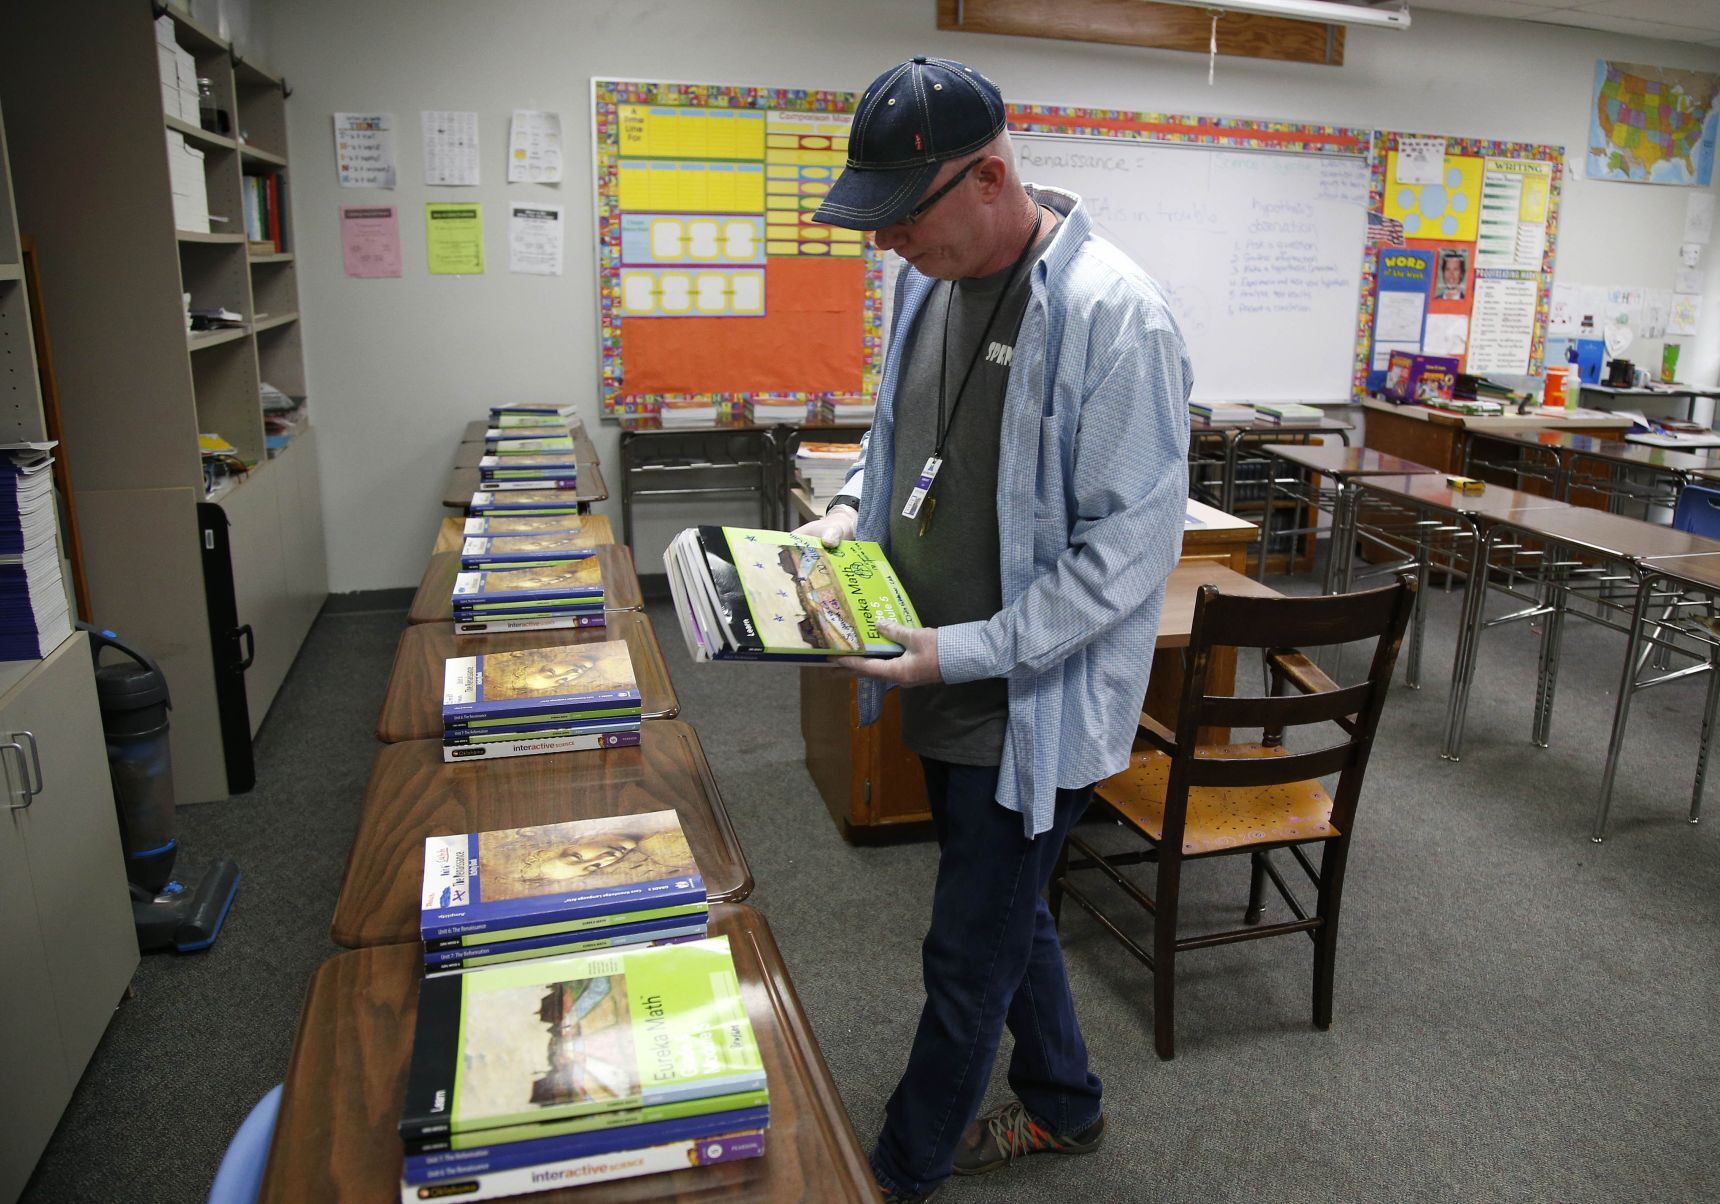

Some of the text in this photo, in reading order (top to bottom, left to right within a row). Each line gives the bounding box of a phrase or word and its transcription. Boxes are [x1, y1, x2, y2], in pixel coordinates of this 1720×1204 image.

[1020, 145, 1129, 171] Renaissance
[1495, 161, 1543, 173] WRITING
[1385, 255, 1426, 270] WORD
[842, 564, 863, 595] Math
[508, 620, 540, 628] interactive
[858, 598, 880, 639] Eureka
[743, 618, 755, 637] Learn
[513, 741, 555, 752] interactive
[460, 923, 487, 932] Renaissance
[463, 948, 490, 957] Reformation
[642, 995, 676, 1080] Eureka Math
[430, 1089, 446, 1113] Learn
[455, 1150, 489, 1160] Reformation
[427, 1170, 439, 1178] Unit
[456, 1163, 489, 1174] Renaissance
[532, 1161, 608, 1183] interactive
[608, 1158, 644, 1171] SCIENCE
